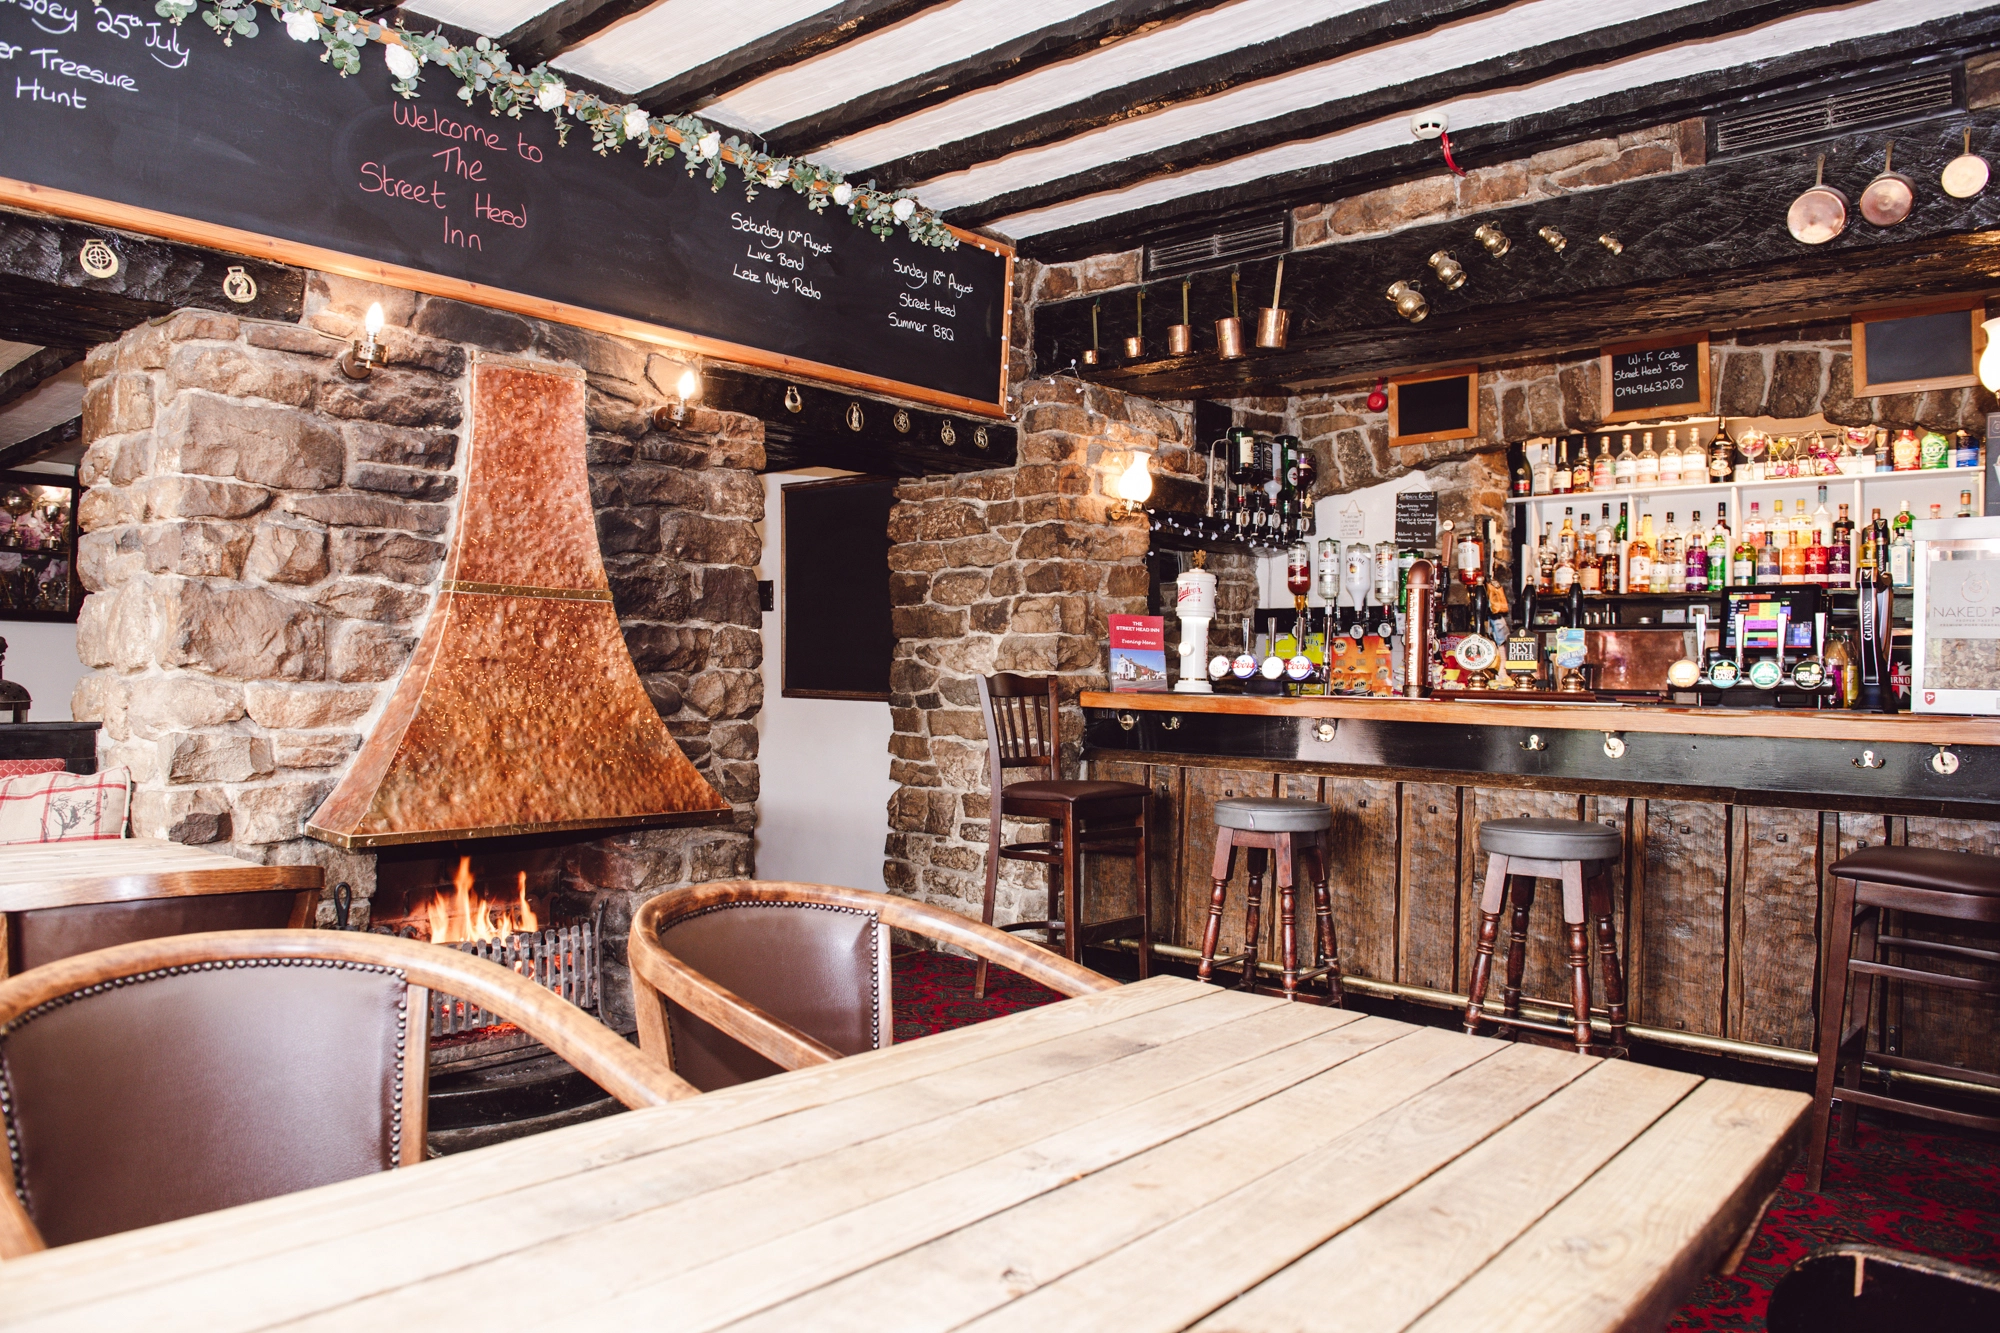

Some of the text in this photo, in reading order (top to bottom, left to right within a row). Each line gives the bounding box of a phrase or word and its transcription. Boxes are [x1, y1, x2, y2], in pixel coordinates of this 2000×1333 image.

[95, 7, 143, 39] 25th
[145, 24, 190, 69] July
[30, 48, 139, 91] Treasure
[16, 76, 87, 109] Hunt
[393, 101, 543, 163] Welcome to
[432, 146, 487, 181] The
[359, 161, 527, 228] Street Head
[444, 216, 482, 251] Inn
[731, 212, 784, 249] Saturday
[804, 233, 833, 257] August
[747, 245, 804, 271] Live Band
[733, 263, 761, 282] Late
[792, 277, 821, 300] Radio
[893, 258, 928, 290] Sunday
[948, 273, 974, 299] August
[899, 293, 956, 317] Street Head
[888, 312, 954, 341] Summer BBQ
[1658, 350, 1681, 361] Code
[1613, 368, 1640, 381] Street
[1641, 364, 1663, 376] Head
[1615, 377, 1684, 397] 01969663282
[1863, 600, 1872, 641] GUINNESS
[1933, 606, 1987, 618] NAKED
[1509, 642, 1535, 654] BEST
[1509, 653, 1535, 661] BITTER
[1231, 659, 1255, 669] Coors
[1286, 660, 1311, 670] Coors
